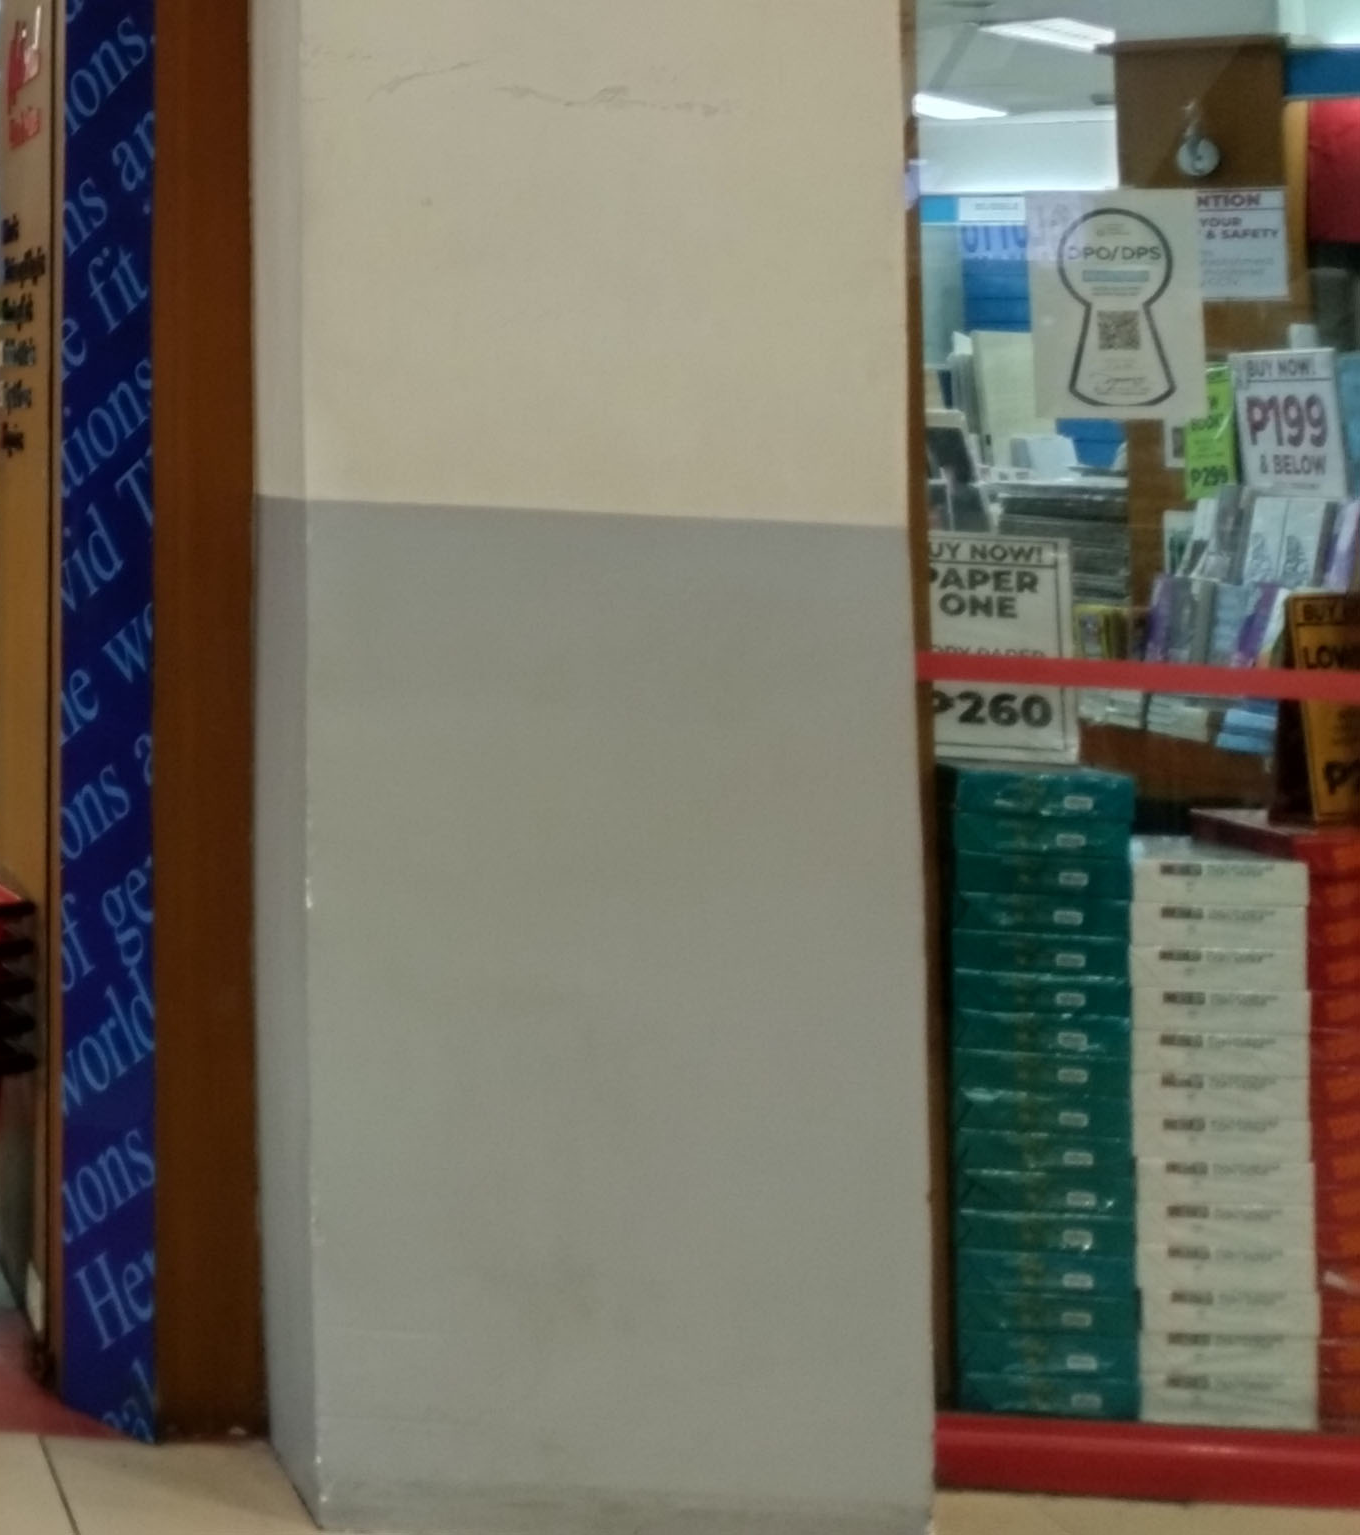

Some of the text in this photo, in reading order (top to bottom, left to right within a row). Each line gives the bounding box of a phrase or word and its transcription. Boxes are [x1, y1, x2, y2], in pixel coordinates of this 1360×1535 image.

[1198, 217, 1242, 229] YOUR
[1205, 228, 1279, 240] & SAFETY
[87, 245, 150, 335] fit
[1272, 453, 1327, 475] BELOW
[970, 543, 1043, 563] NOW!
[939, 592, 1018, 619] ONE
